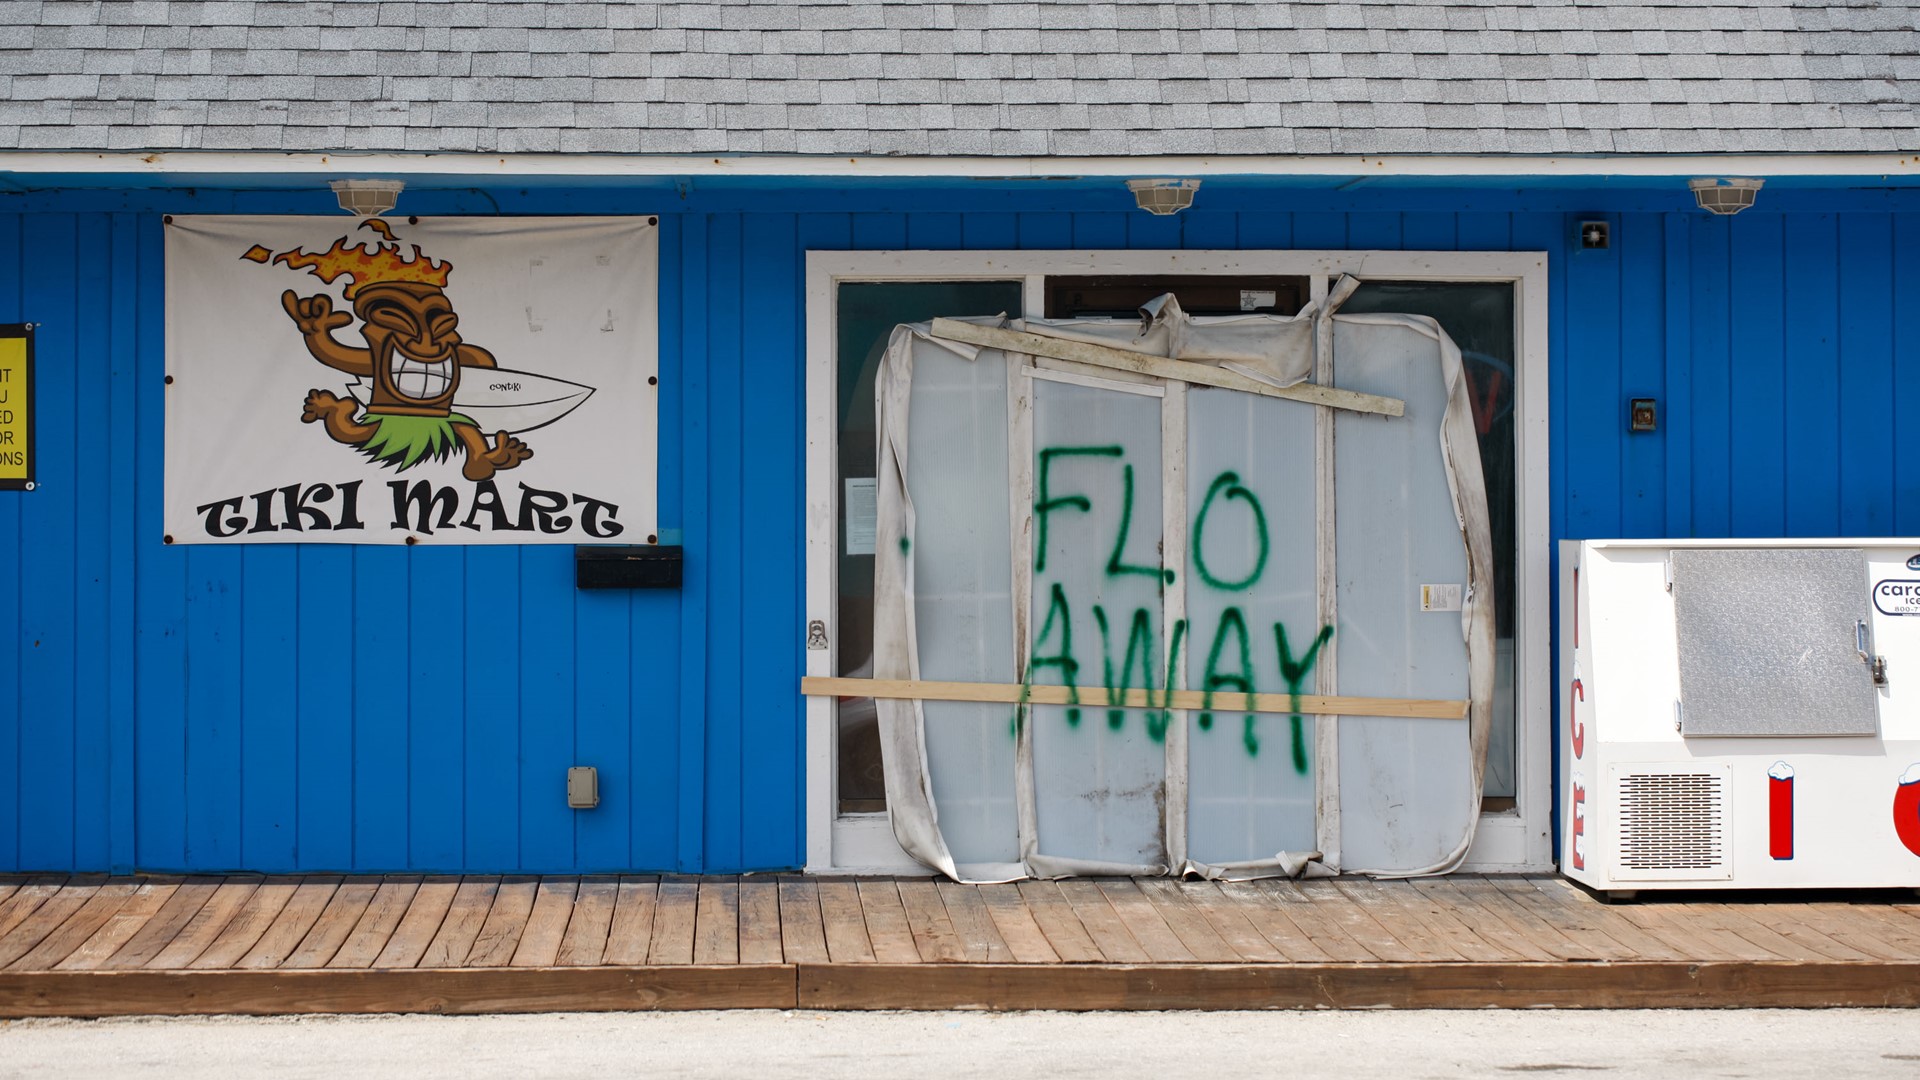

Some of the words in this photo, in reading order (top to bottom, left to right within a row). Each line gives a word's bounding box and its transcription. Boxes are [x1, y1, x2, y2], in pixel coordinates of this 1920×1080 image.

[197, 479, 365, 538] TIKI
[386, 479, 625, 539] MART
[1034, 445, 1270, 593] FLO
[1010, 582, 1334, 776] AWAY
[1570, 565, 1586, 872] ICE
